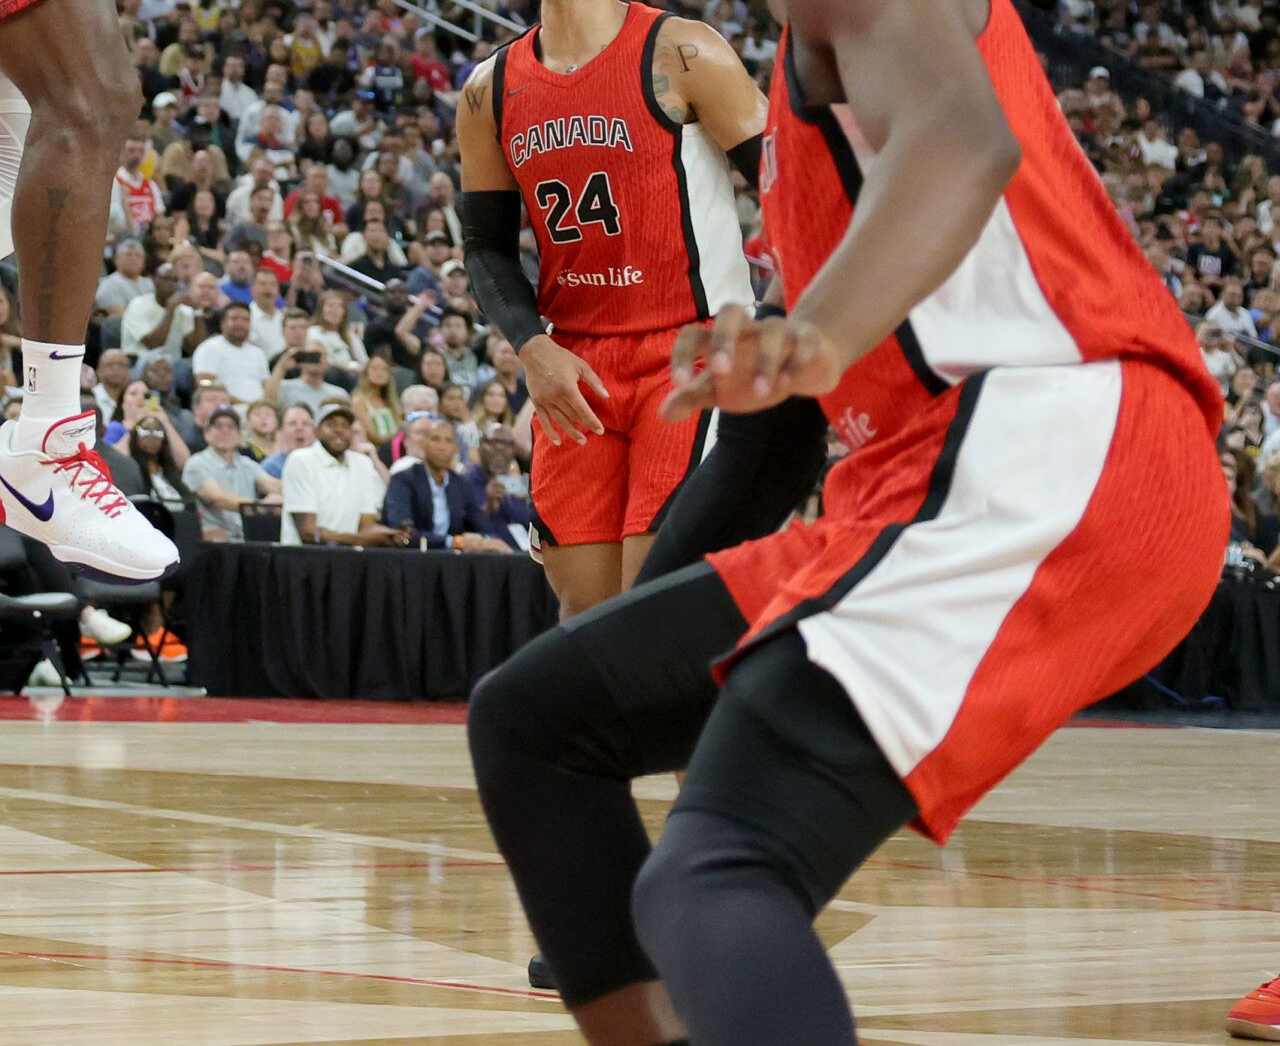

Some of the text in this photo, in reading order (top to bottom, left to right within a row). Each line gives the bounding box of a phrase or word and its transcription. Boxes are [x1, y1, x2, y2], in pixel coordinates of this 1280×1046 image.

[510, 115, 634, 169] CANADA
[534, 171, 622, 245] 24
[566, 265, 645, 287] Sun Life
[839, 405, 878, 450] ife
